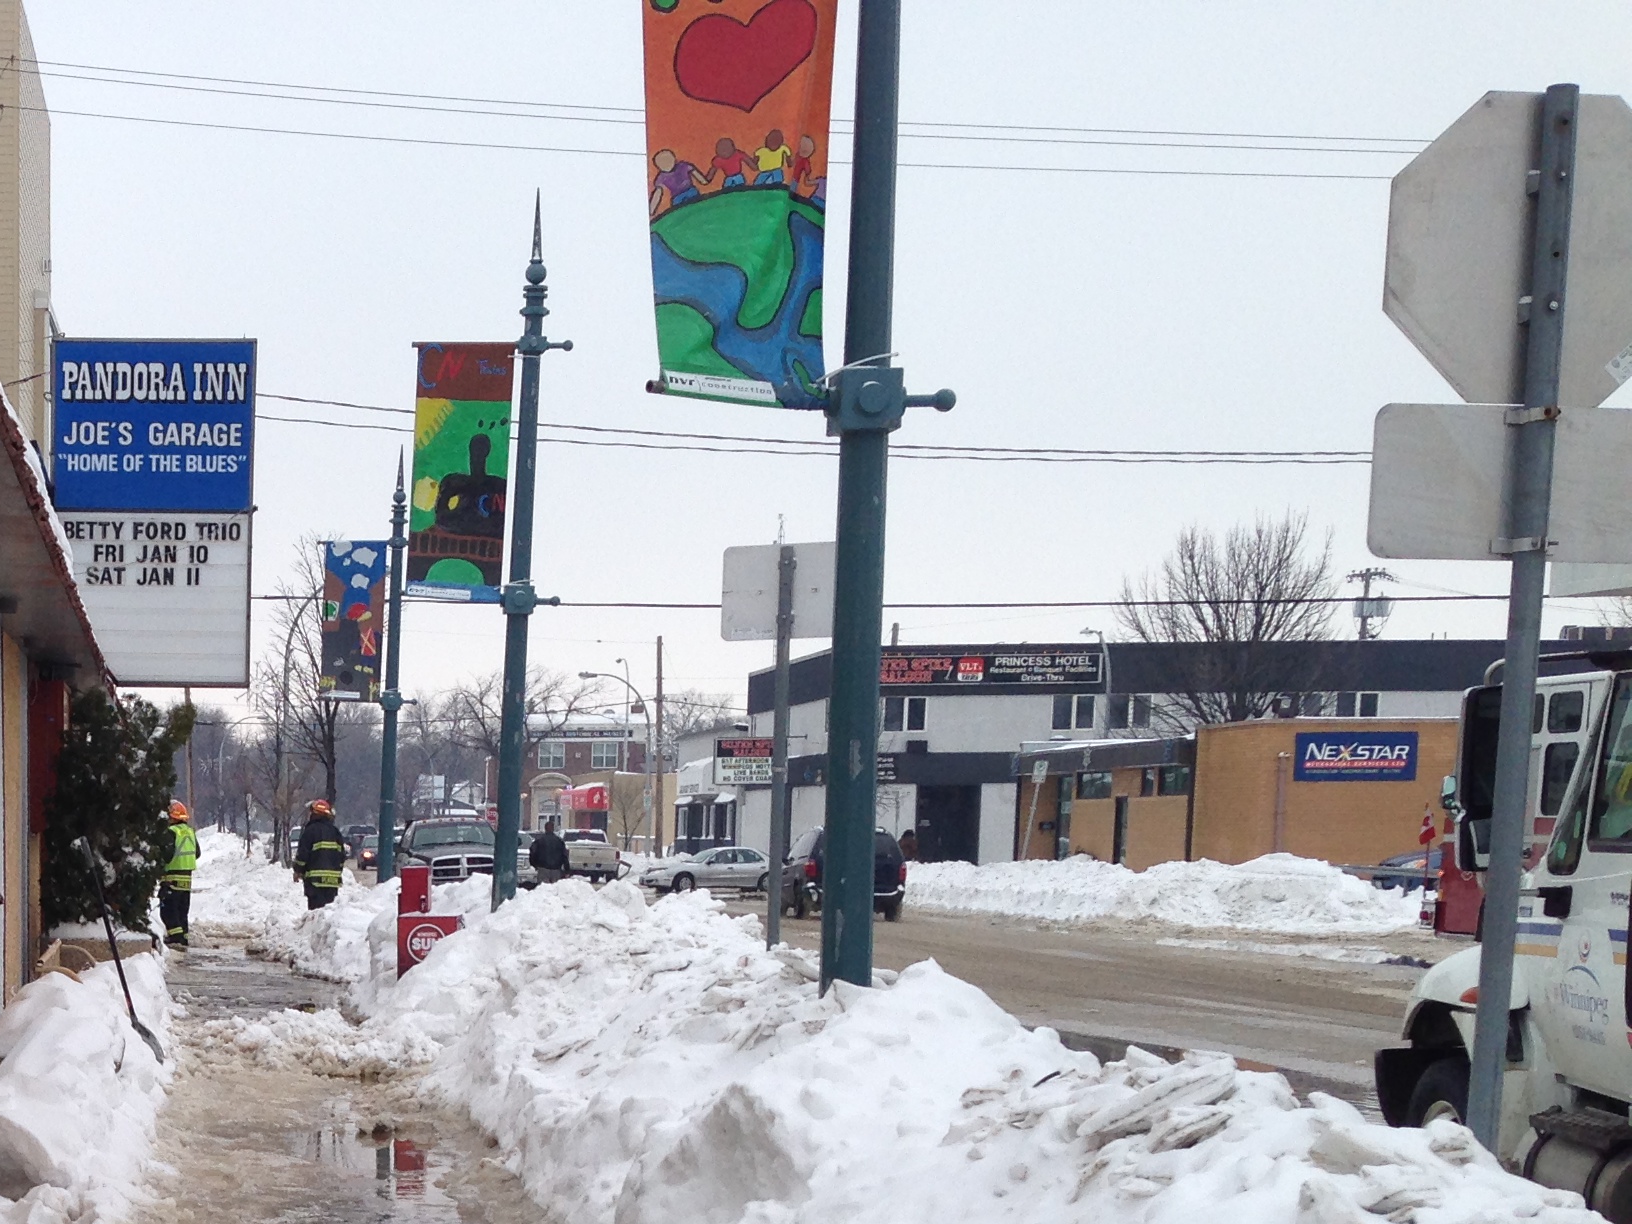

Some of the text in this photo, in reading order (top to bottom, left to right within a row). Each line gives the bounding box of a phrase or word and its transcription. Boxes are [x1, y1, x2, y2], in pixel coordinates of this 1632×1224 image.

[62, 361, 248, 403] PANDORA INN
[63, 421, 242, 447] JOE'S GARAGE
[58, 453, 247, 473] "HOME OF THE BLUES"
[64, 521, 241, 541] BETTY FORD TRIO
[93, 545, 209, 564] FRI JAN 10
[85, 567, 200, 586] SAT JAN 11
[995, 656, 1092, 666] PRINCESS HOTEL
[411, 937, 440, 950] SU
